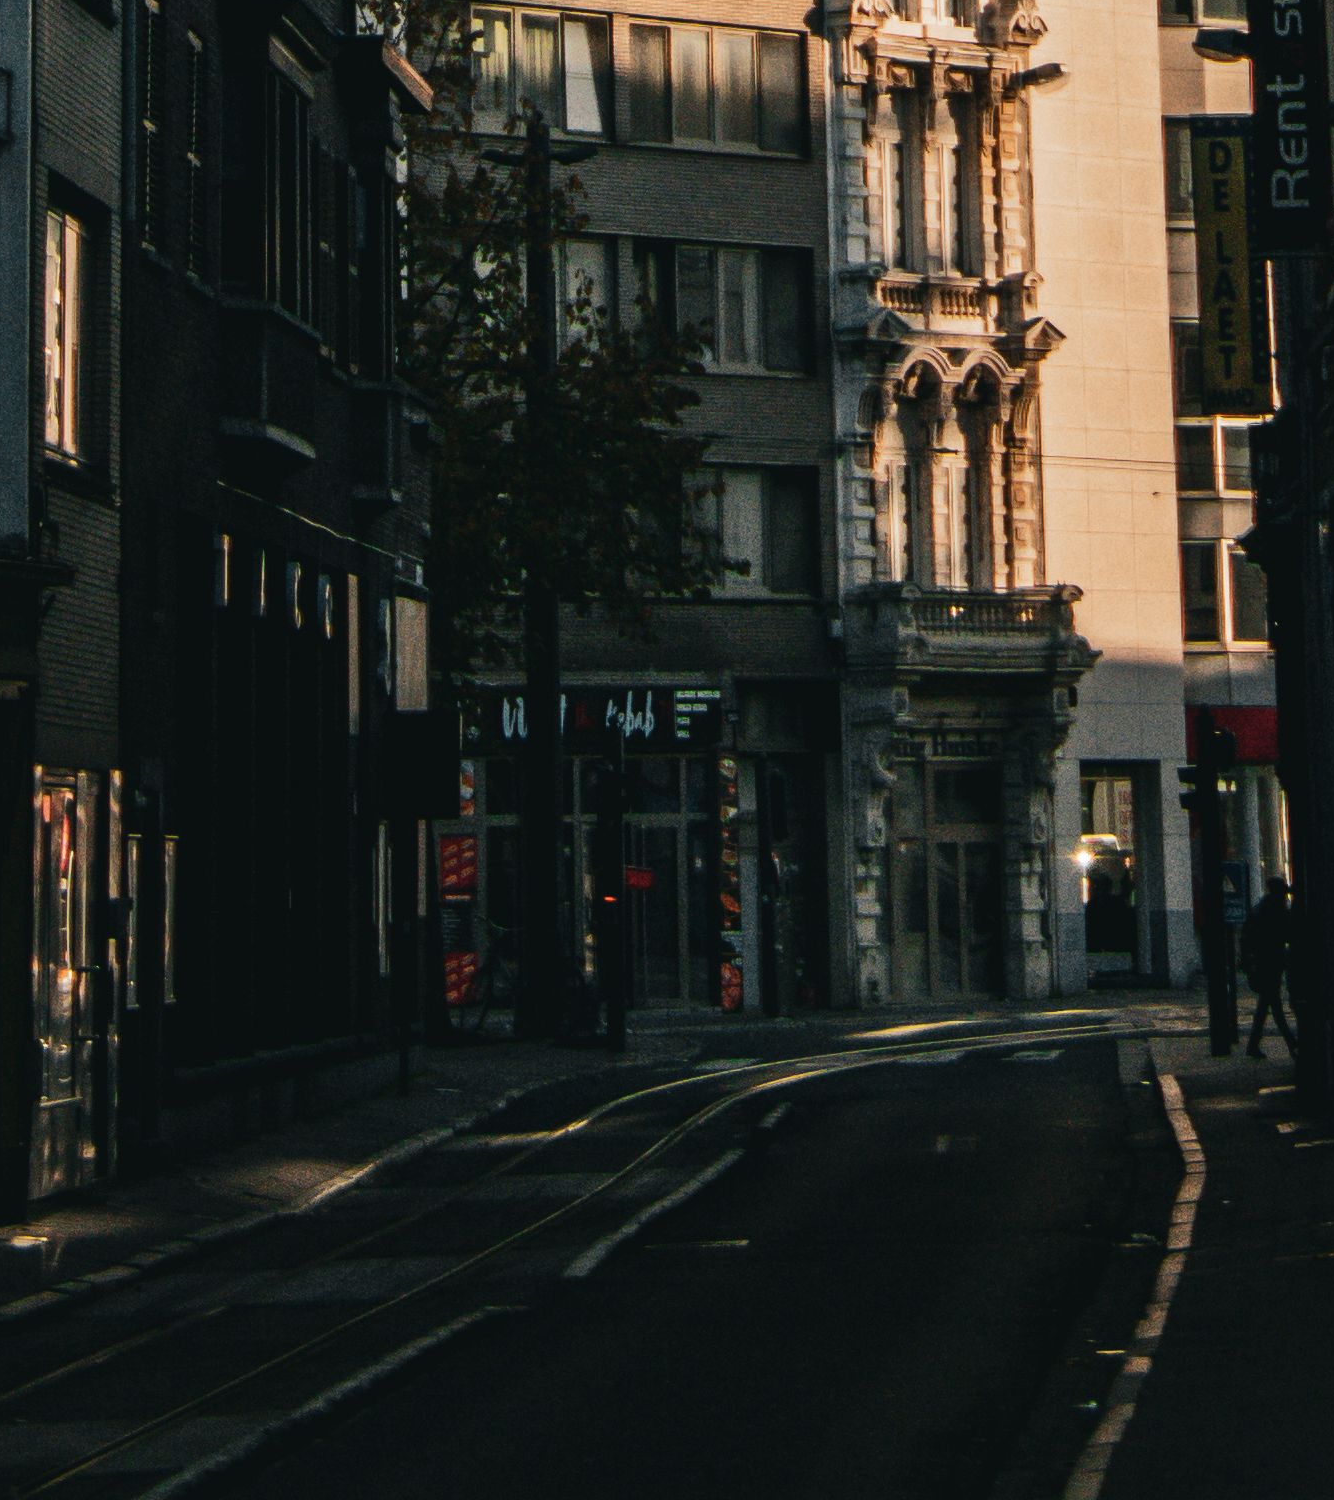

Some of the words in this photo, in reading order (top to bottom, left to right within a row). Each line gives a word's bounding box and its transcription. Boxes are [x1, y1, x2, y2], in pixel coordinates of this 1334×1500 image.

[1208, 140, 1233, 213] DE
[1267, 73, 1311, 210] Rent
[1213, 230, 1238, 380] LAET
